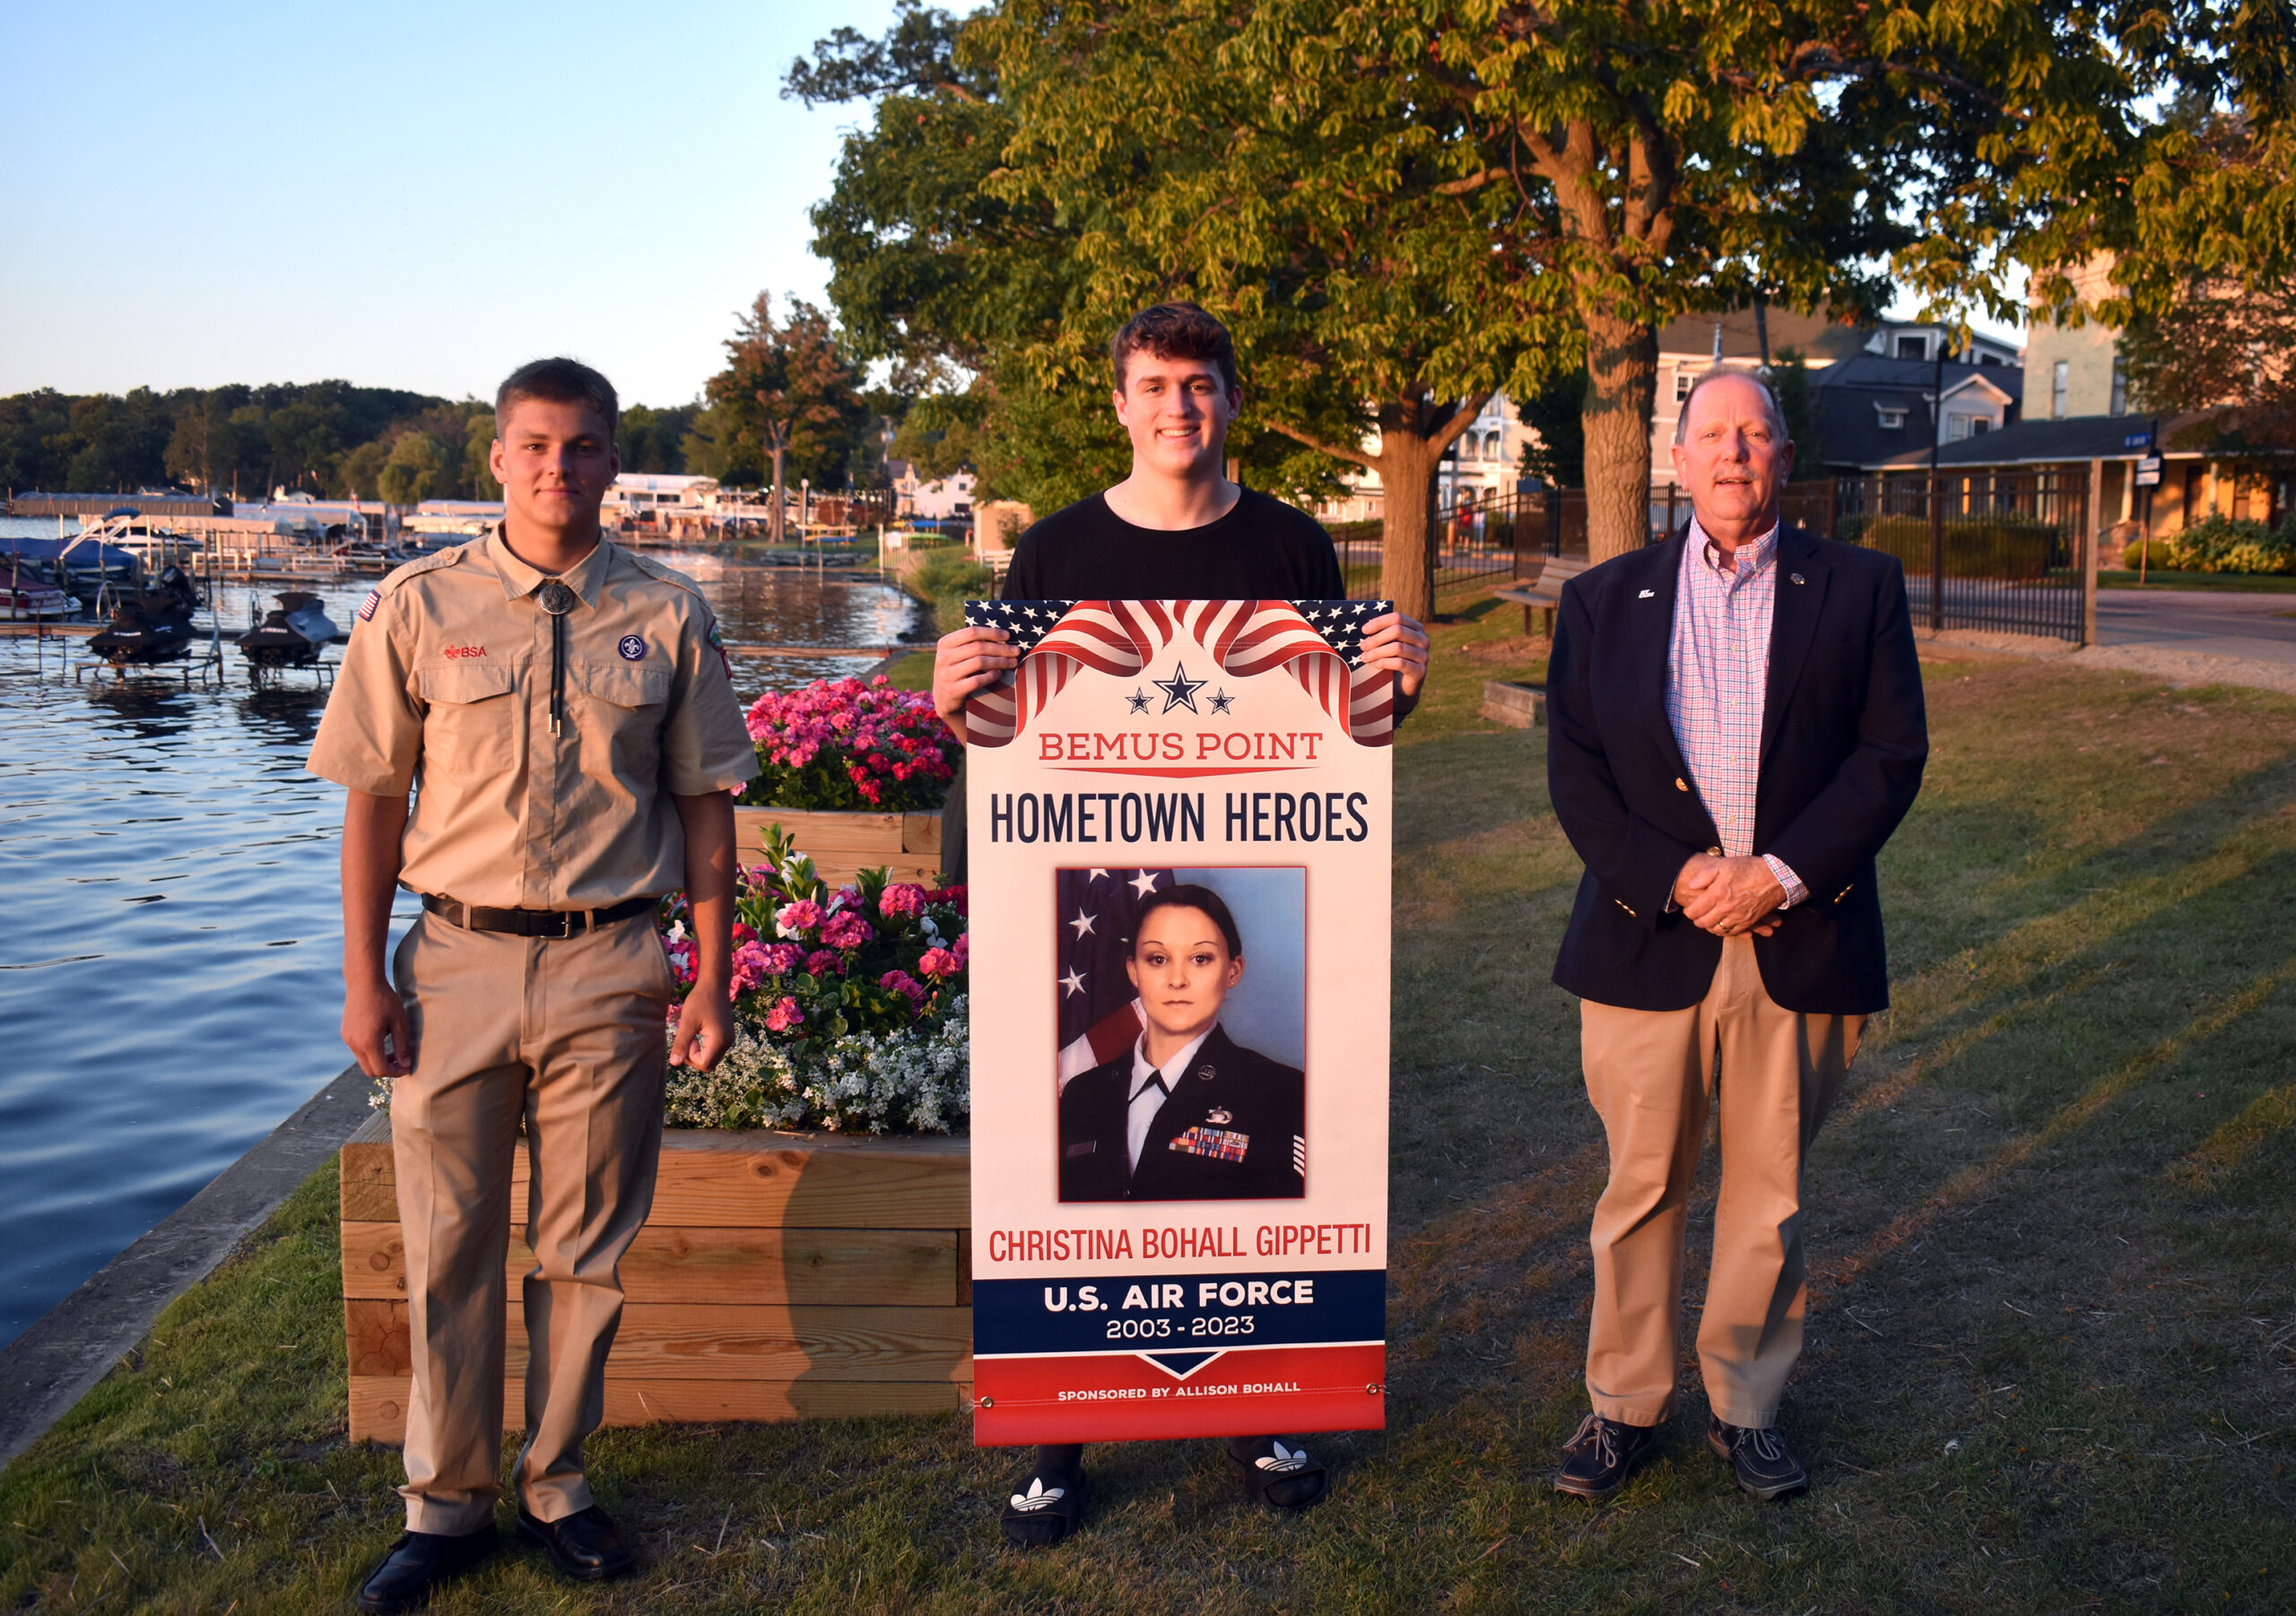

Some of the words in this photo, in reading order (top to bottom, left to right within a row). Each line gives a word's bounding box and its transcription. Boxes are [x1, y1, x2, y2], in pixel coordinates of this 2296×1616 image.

[461, 646, 487, 657] BSA
[1039, 732, 1185, 761] BEMUS
[1196, 732, 1323, 760] POINT
[991, 793, 1205, 844] HOMETOWN
[1226, 792, 1369, 842] HEROES
[989, 1229, 1133, 1262] CHRISTINA
[1142, 1227, 1247, 1258] BOHALL
[1256, 1223, 1370, 1256] GIPPETTI
[1044, 1286, 1108, 1311] U.S.
[1122, 1284, 1184, 1308] AIR
[1199, 1281, 1314, 1307] FORCE
[1106, 1319, 1170, 1338] 2003
[1191, 1316, 1255, 1335] 2023
[1057, 1389, 1147, 1402] SPONSORED
[1152, 1387, 1170, 1398] BY
[1175, 1385, 1238, 1396] ALLISON
[1242, 1382, 1301, 1394] BOHALL
